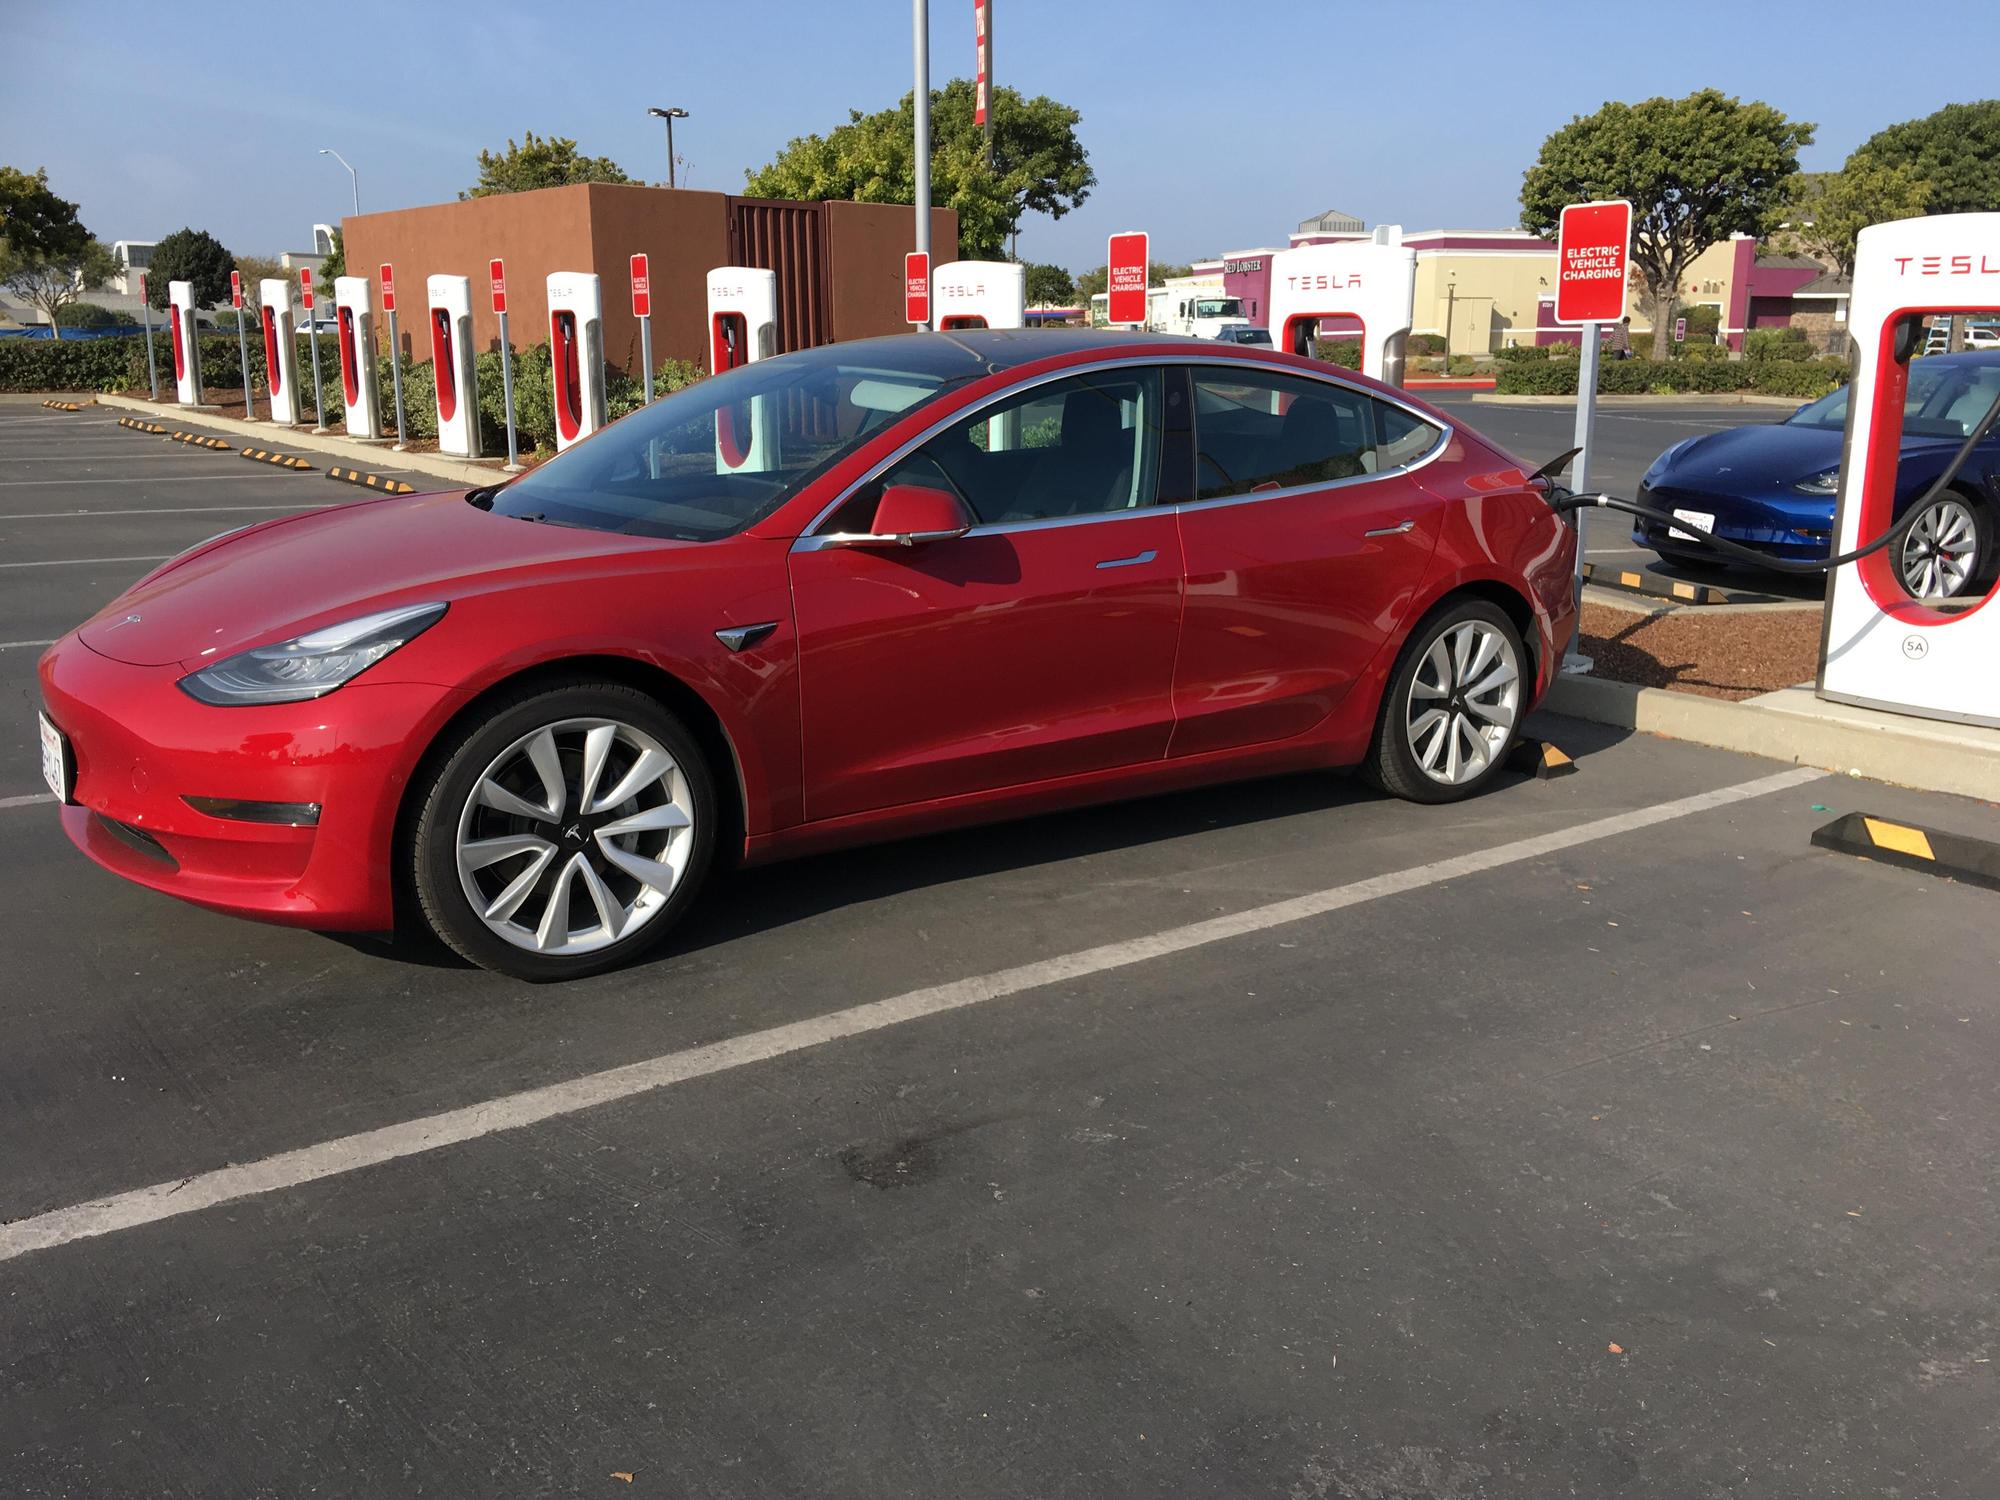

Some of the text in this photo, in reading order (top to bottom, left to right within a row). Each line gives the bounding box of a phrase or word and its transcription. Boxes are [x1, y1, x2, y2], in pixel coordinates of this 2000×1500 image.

[1567, 246, 1620, 258] ELECTRIC
[1224, 260, 1262, 274] RED LOBSTER
[1570, 257, 1616, 269] VEHICLE
[1112, 266, 1143, 275] ELECTRIC
[1563, 268, 1622, 280] CHARGING
[1114, 275, 1141, 283] VEHICLE
[1288, 275, 1361, 291] TESLA
[712, 287, 743, 297] TESLA
[941, 285, 985, 297] TESLA
[1111, 283, 1144, 292] CHARGING
[1906, 641, 1923, 652] 5A
